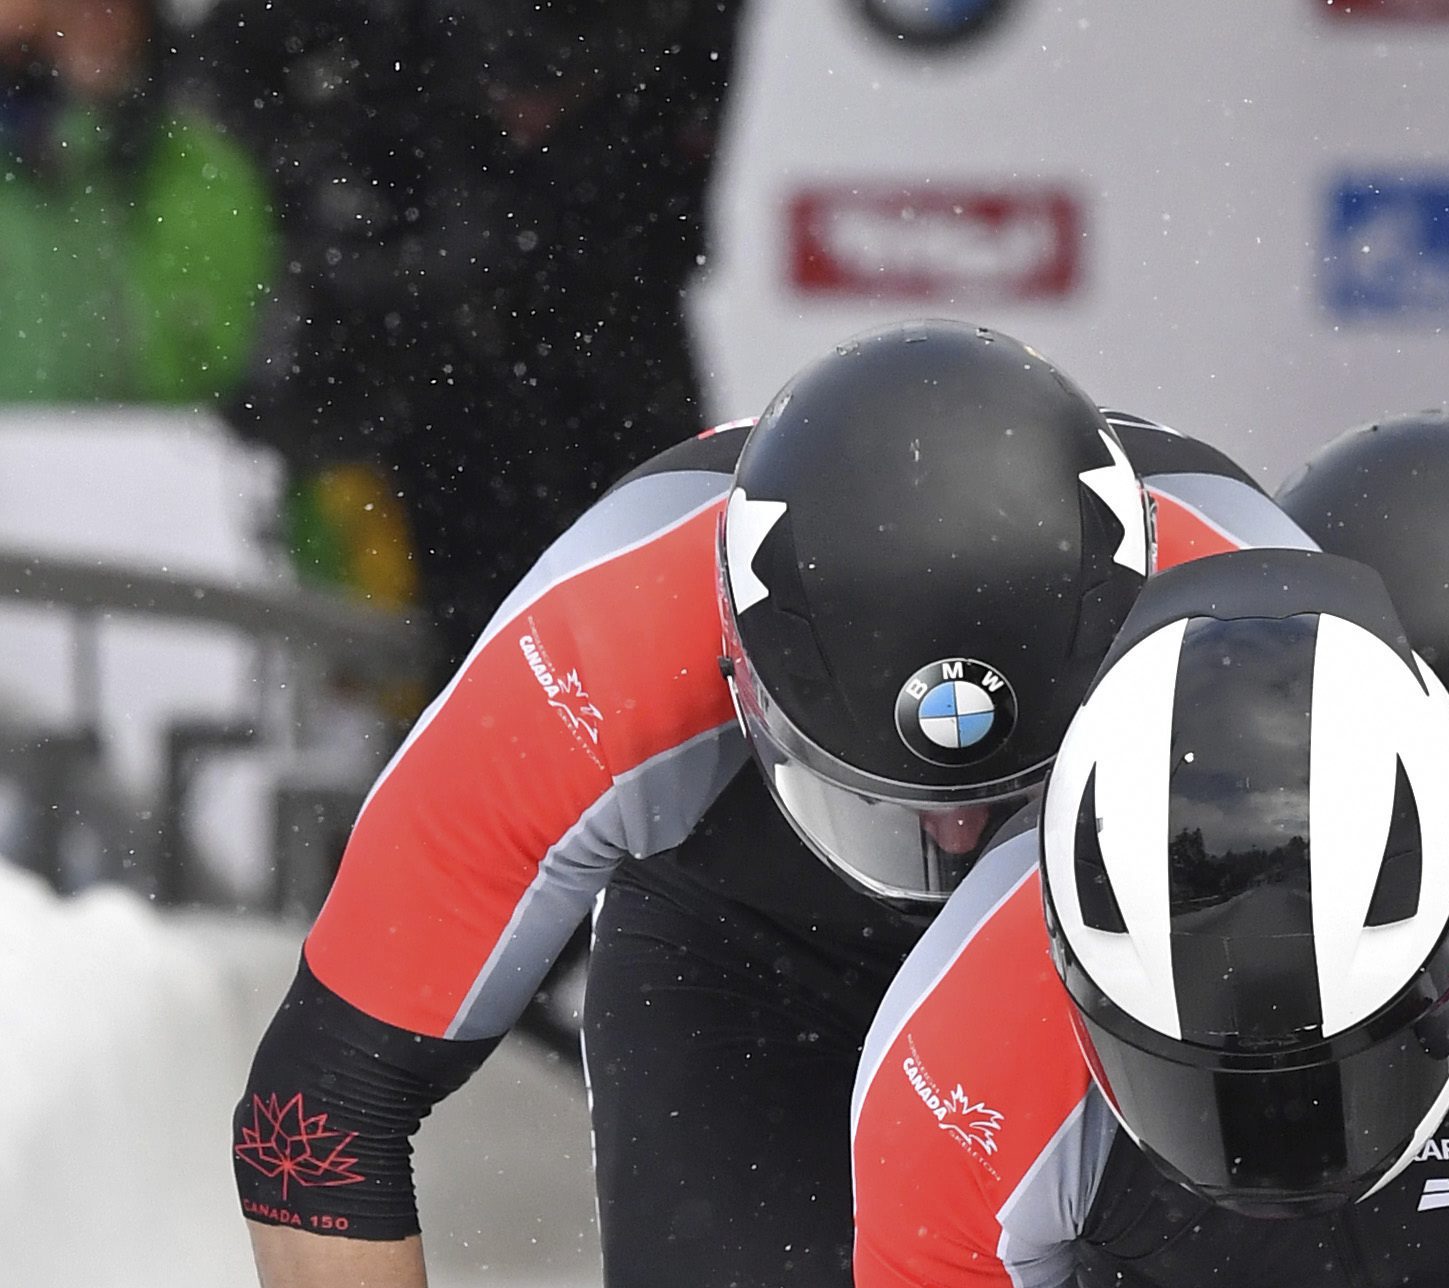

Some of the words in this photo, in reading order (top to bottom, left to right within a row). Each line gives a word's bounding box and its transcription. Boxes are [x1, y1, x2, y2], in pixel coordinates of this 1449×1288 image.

[519, 635, 560, 698] CANADA
[905, 661, 1004, 700] BMW
[903, 1057, 947, 1121] CANADA
[243, 1199, 301, 1225] CANADA
[309, 1215, 349, 1231] 150
